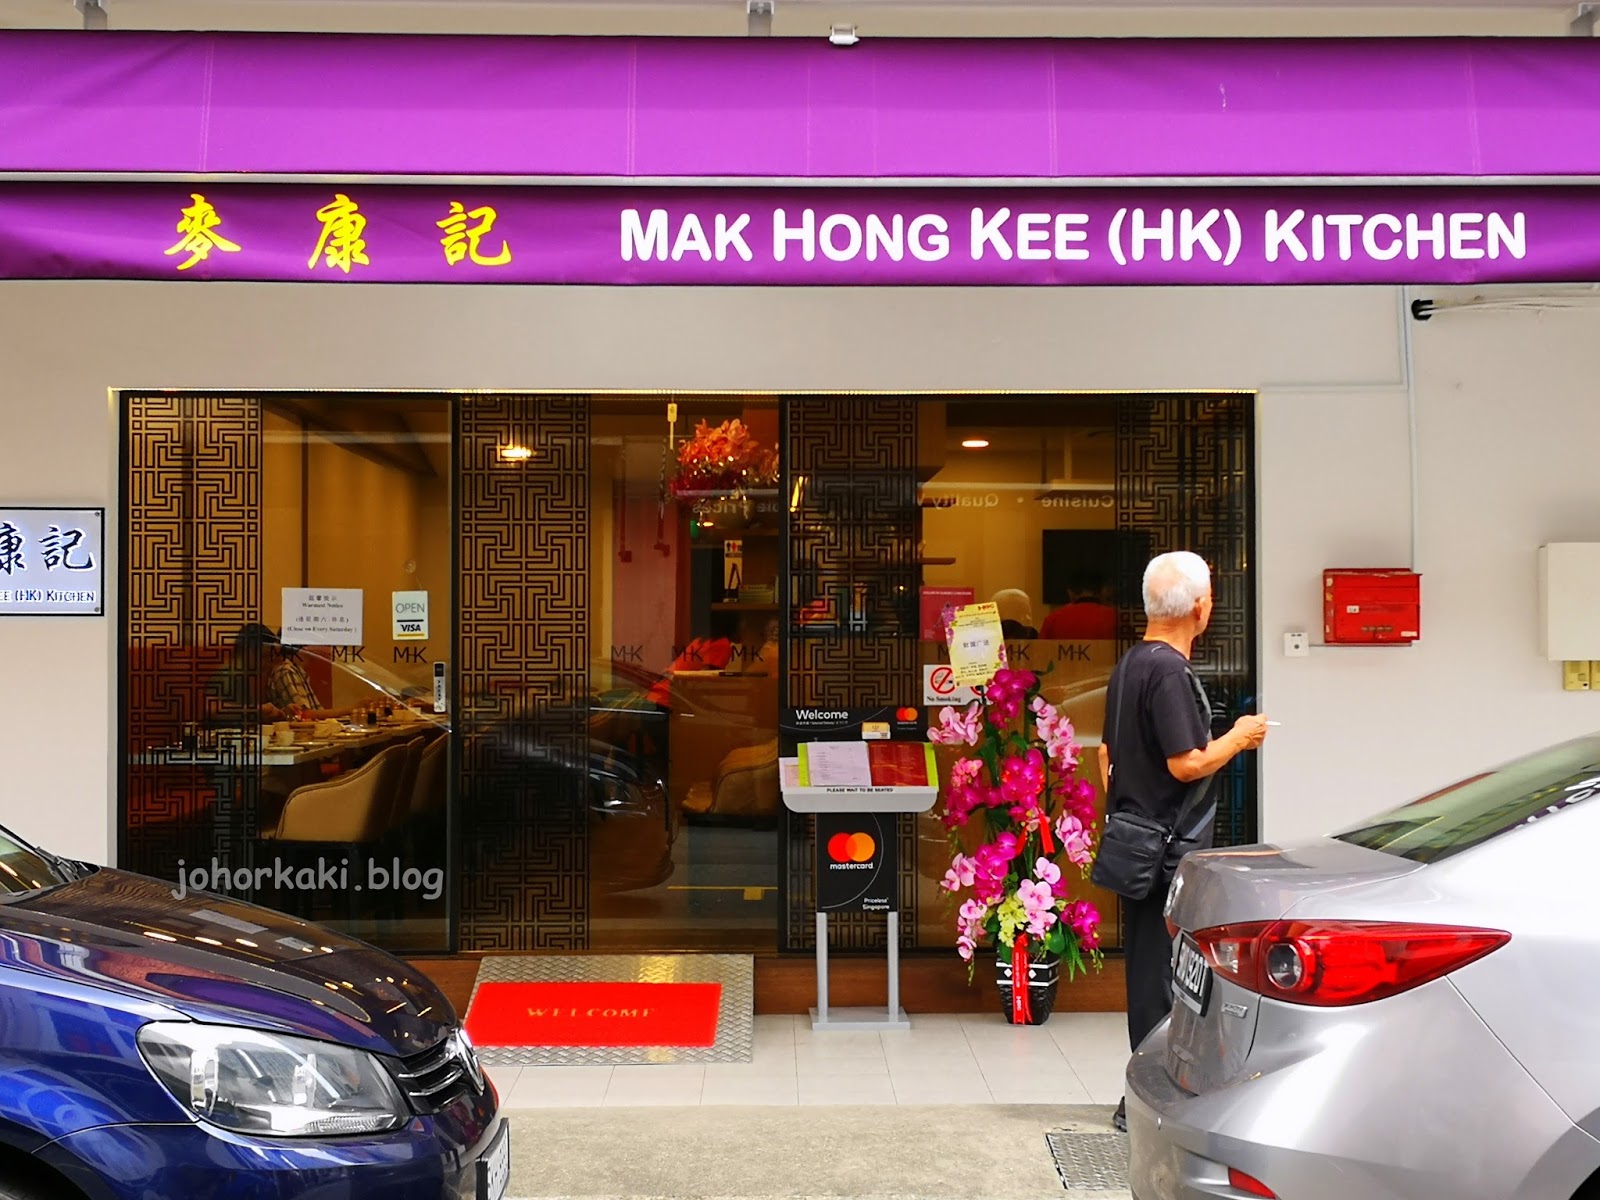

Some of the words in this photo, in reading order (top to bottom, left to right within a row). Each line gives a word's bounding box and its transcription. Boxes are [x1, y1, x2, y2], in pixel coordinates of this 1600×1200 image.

[164, 193, 512, 274] 麥康記
[620, 208, 753, 262] MAK
[773, 208, 950, 262] HONG
[970, 207, 1090, 261] KEE
[1108, 207, 1242, 266] (HK)
[1264, 208, 1526, 262] KITCHEN
[46, 590, 95, 602] KITCHEN
[395, 603, 425, 614] OPEN
[401, 624, 421, 632] VISA
[936, 695, 962, 703] Smoking
[796, 709, 849, 720] Welcome
[829, 861, 874, 870] mastercard
[526, 1007, 656, 1018] WELCOME
